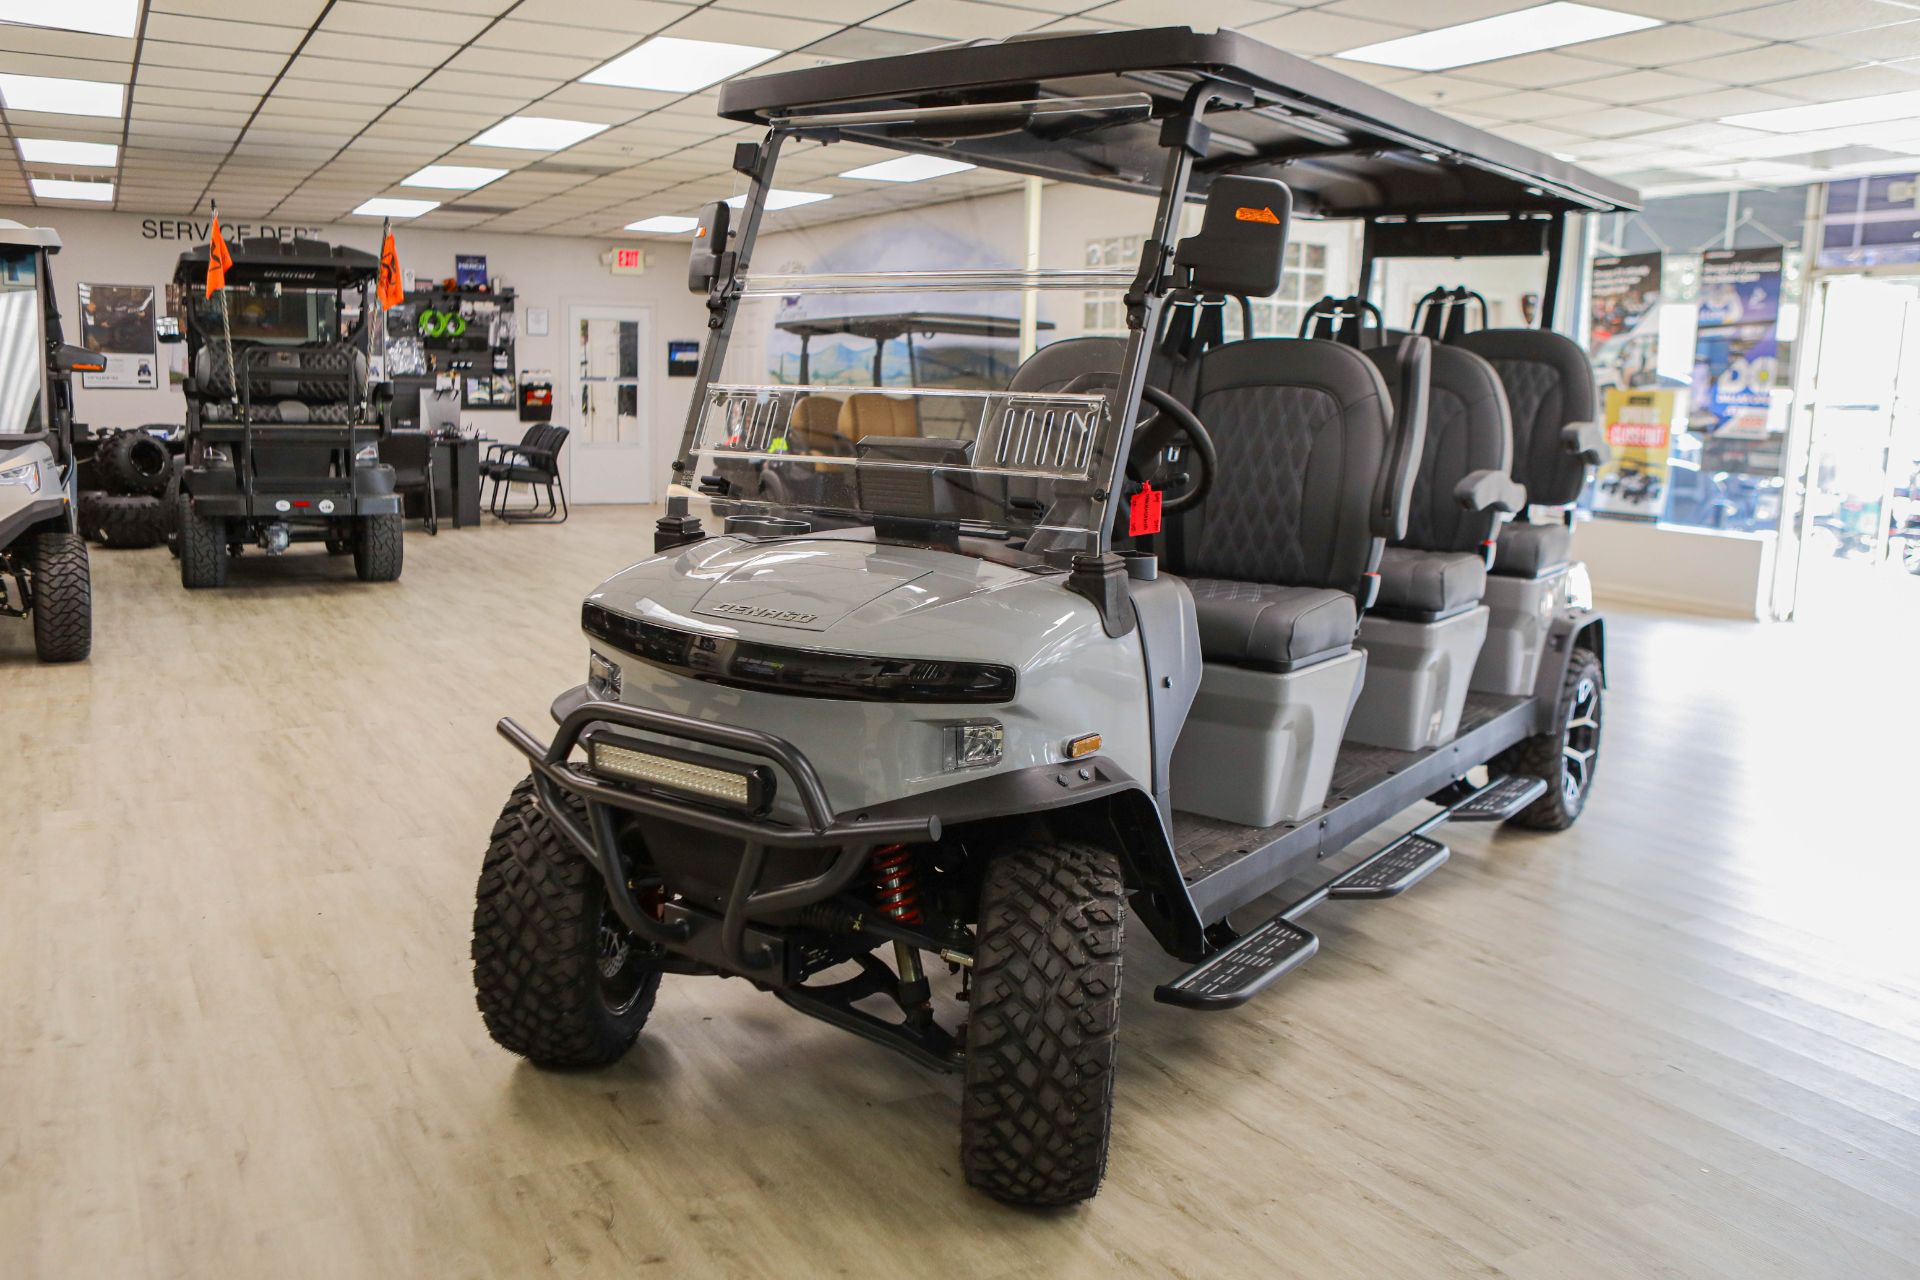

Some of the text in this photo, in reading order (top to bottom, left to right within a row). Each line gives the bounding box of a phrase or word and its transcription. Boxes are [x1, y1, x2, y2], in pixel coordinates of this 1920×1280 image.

[142, 219, 250, 242] SERVCE
[618, 249, 639, 268] EXIT
[712, 603, 819, 624] DENAGO
